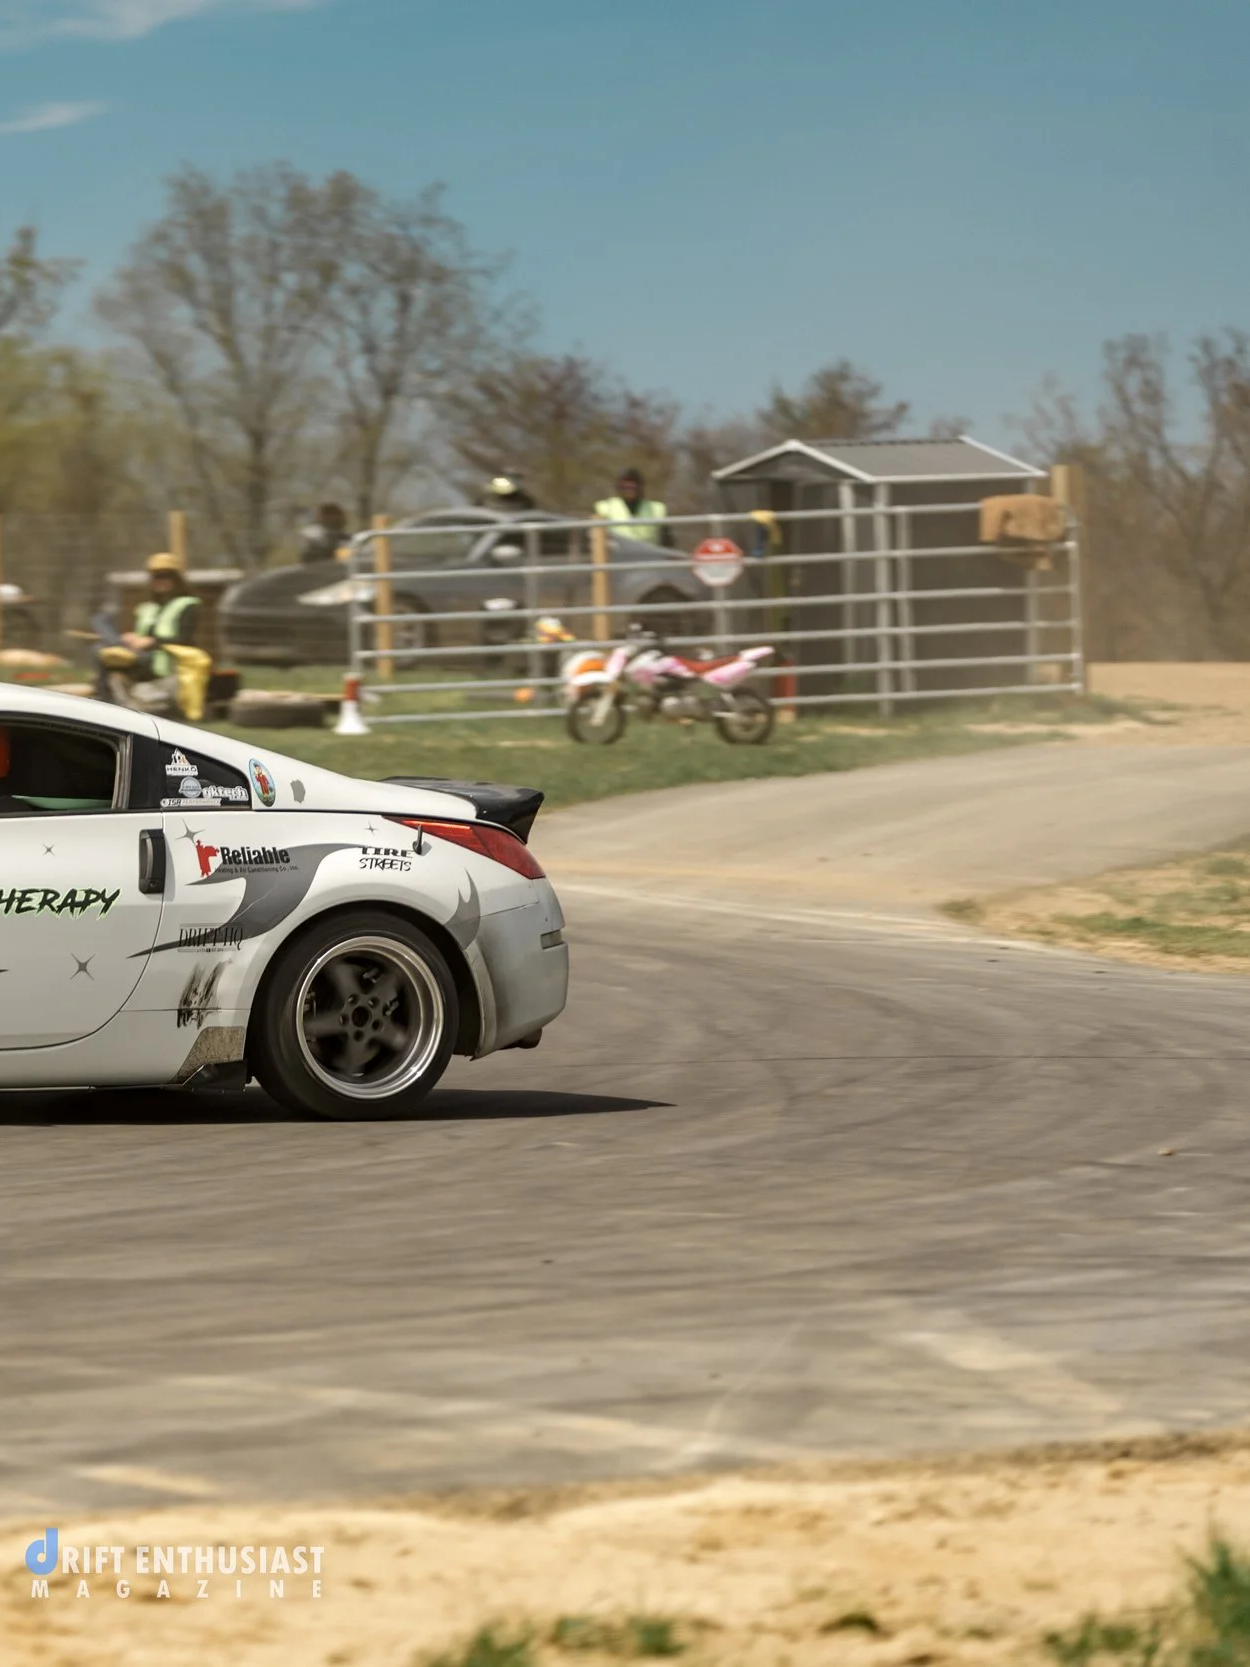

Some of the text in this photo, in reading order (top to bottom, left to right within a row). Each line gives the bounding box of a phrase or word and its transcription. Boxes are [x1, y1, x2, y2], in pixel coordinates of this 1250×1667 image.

[219, 846, 291, 865] Reliable
[358, 846, 414, 858] TIRE
[359, 857, 412, 871] STREETS
